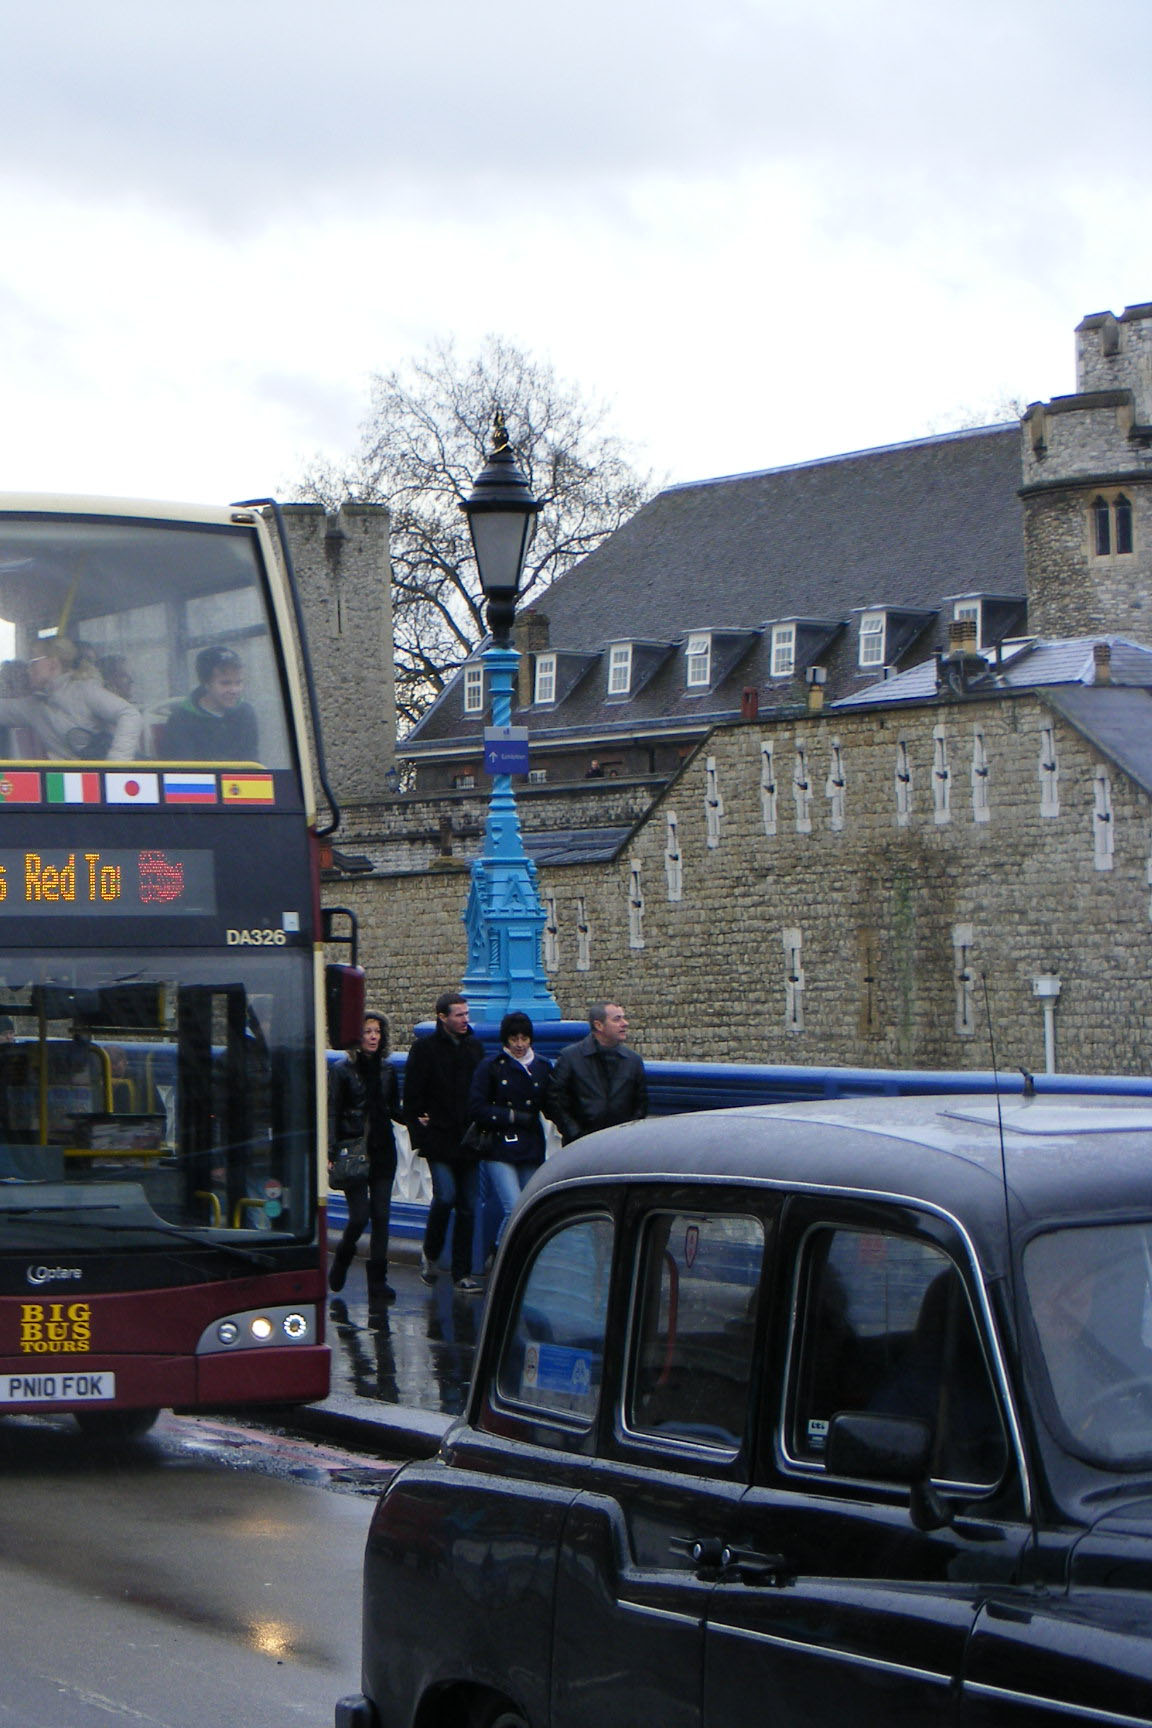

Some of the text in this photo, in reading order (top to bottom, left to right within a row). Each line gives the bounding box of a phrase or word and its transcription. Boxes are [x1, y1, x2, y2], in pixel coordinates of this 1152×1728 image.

[25, 853, 76, 901] Red
[84, 853, 121, 901] To
[226, 929, 287, 946] DA326
[20, 1303, 92, 1322] BIG
[20, 1322, 92, 1341] BUS
[20, 1340, 90, 1353] TOURS
[9, 1375, 103, 1398] PN10 FOK
